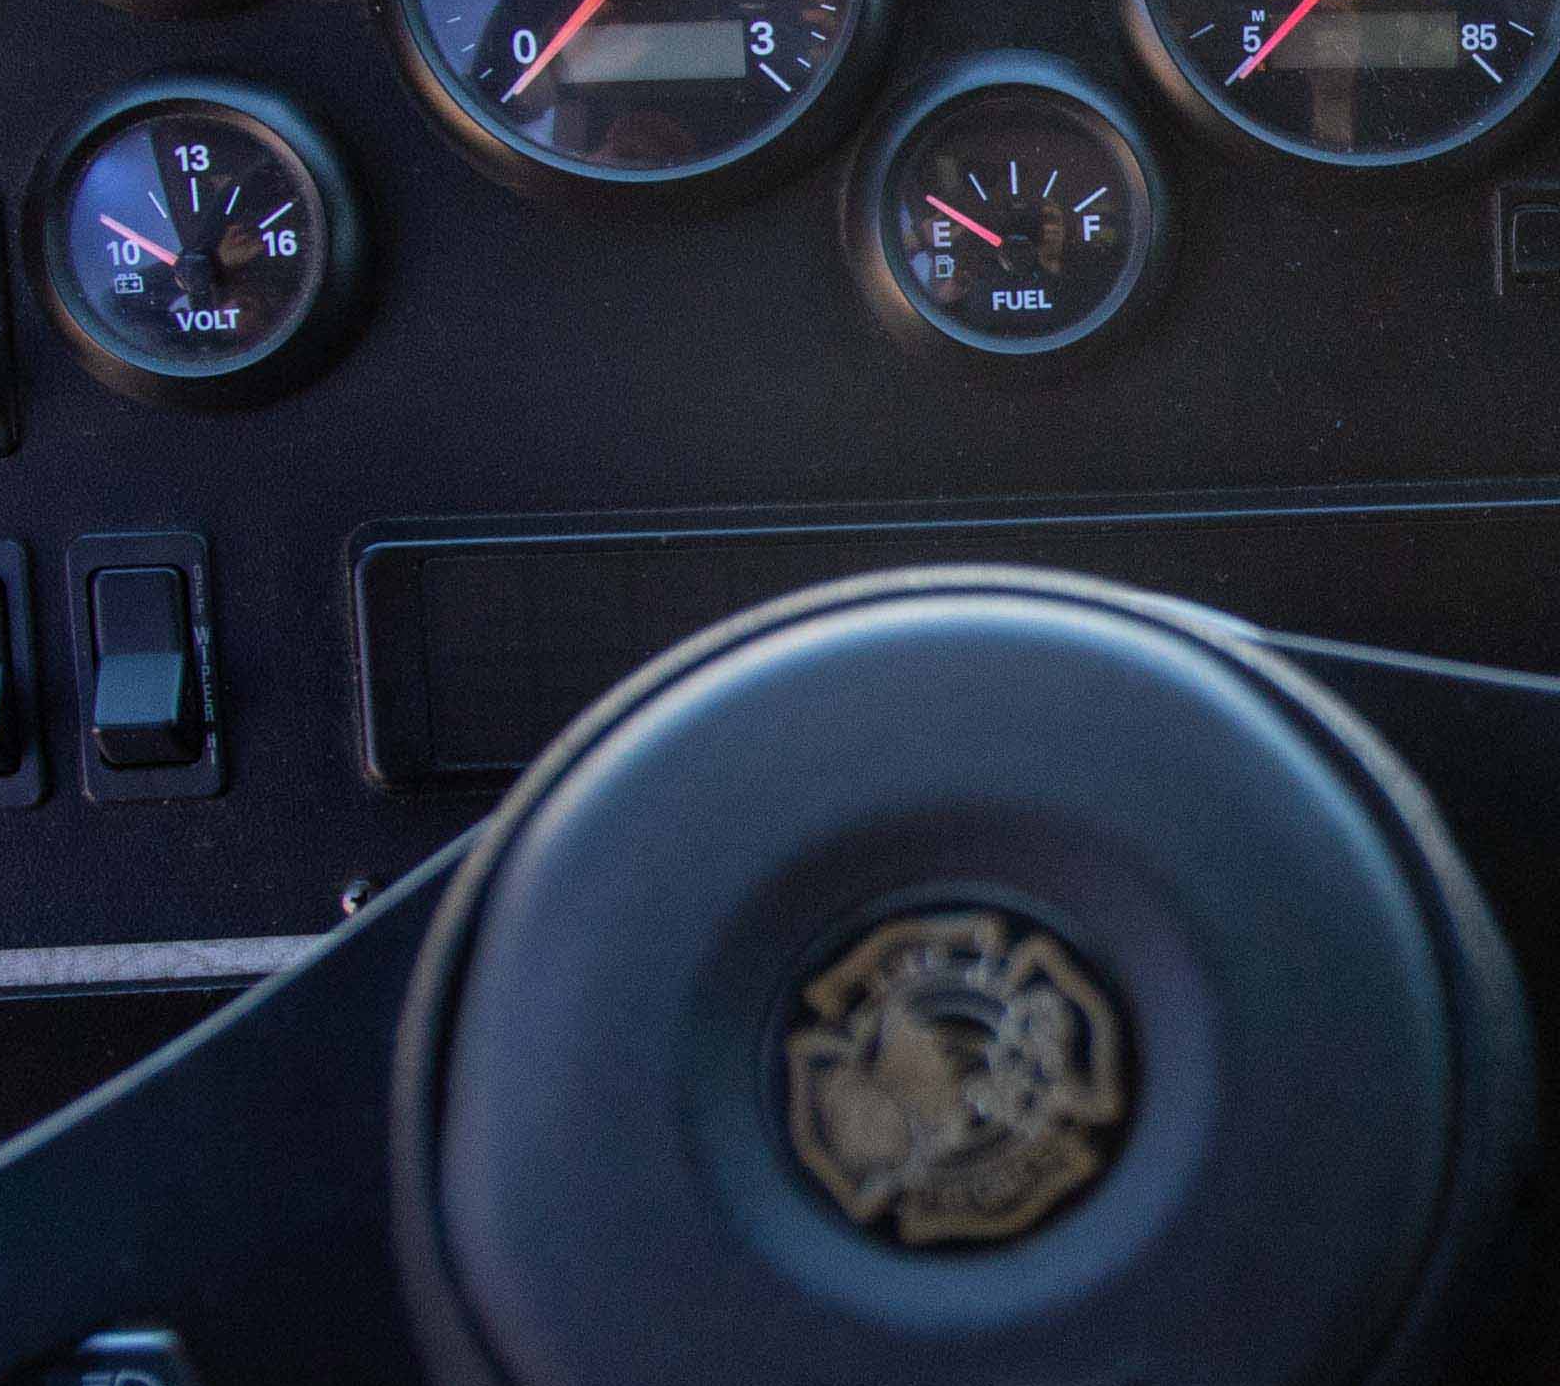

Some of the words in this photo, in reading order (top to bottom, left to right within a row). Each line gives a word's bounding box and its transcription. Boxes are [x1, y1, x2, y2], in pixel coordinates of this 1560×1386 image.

[1251, 10, 1265, 22] M
[512, 30, 536, 64] 0
[749, 21, 775, 55] 3
[1243, 25, 1261, 53] 5
[1461, 24, 1497, 51] 85
[175, 145, 209, 172] 13
[933, 221, 952, 248] E
[1083, 215, 1100, 241] F
[107, 240, 140, 268] 10
[262, 229, 297, 257] 16
[992, 290, 1052, 310] FUEL
[176, 309, 241, 332] VOLT
[193, 626, 215, 722] WIPER
